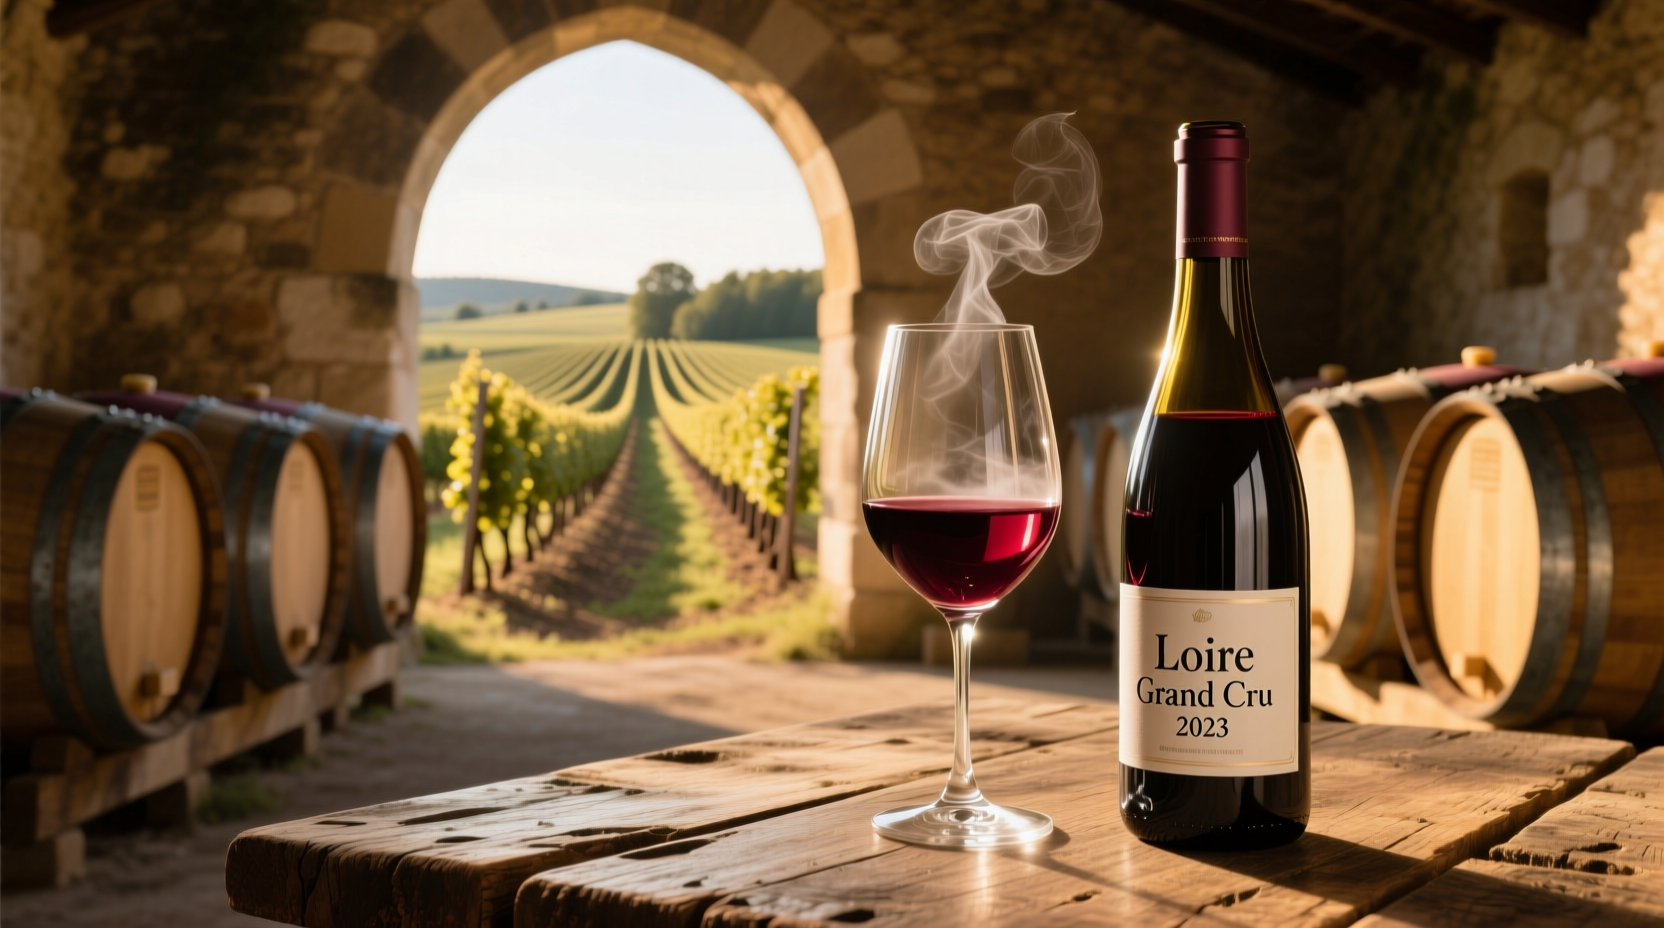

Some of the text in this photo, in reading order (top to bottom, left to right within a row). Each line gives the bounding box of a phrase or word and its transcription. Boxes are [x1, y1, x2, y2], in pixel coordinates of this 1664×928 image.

[1154, 633, 1254, 673] Loire
[1136, 676, 1273, 708] Grand Cru
[1176, 716, 1229, 738] 2023
